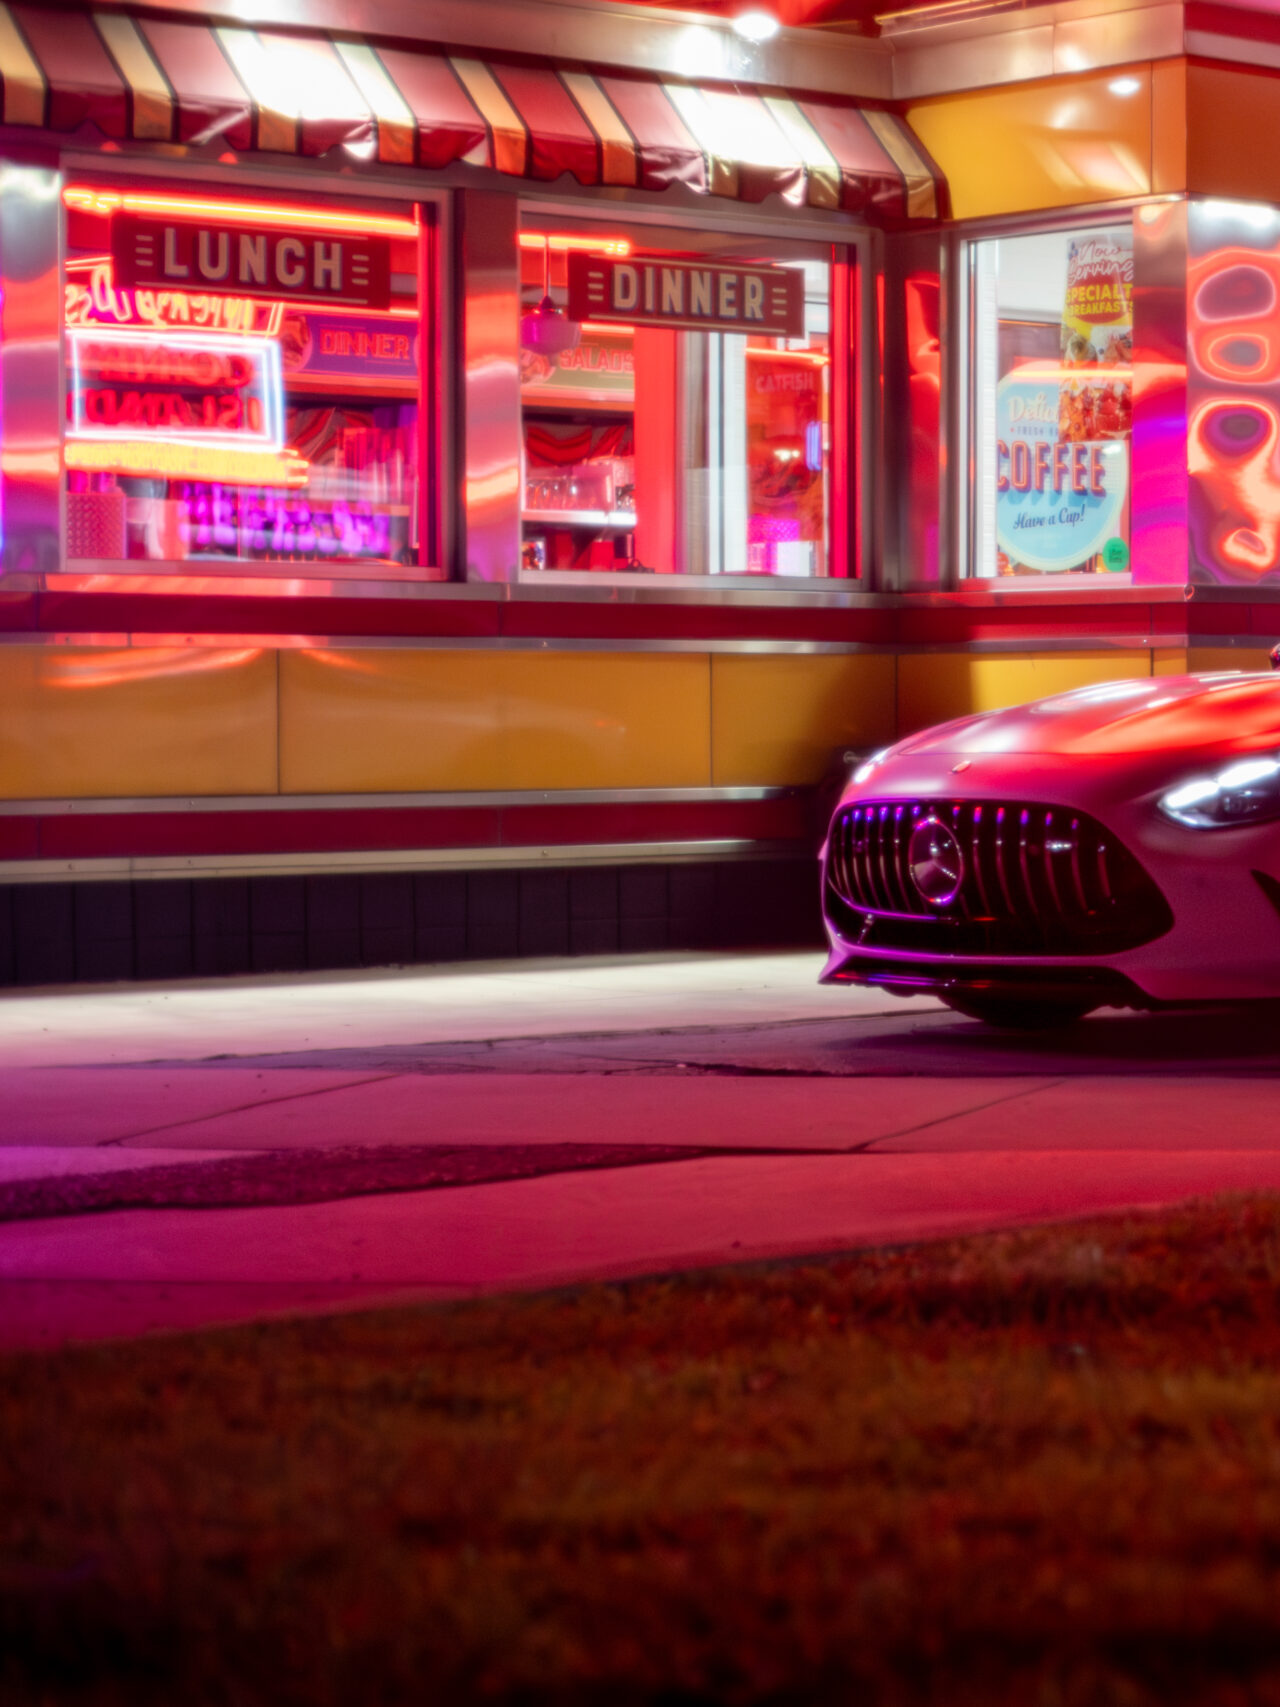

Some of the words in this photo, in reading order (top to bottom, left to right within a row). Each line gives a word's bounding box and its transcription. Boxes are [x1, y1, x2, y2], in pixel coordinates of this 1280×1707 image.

[163, 228, 343, 290] LUNCH
[1068, 258, 1134, 287] Serving
[613, 264, 764, 320] DINNER
[1066, 283, 1133, 302] SPECIALT
[319, 329, 409, 359] DINNER
[559, 347, 635, 373] SALADS
[755, 371, 813, 393] CATFISH
[997, 440, 1107, 498] COFFEE
[1013, 512, 1045, 530] Have
[1049, 516, 1056, 526] a
[1058, 504, 1085, 529] Cup!
